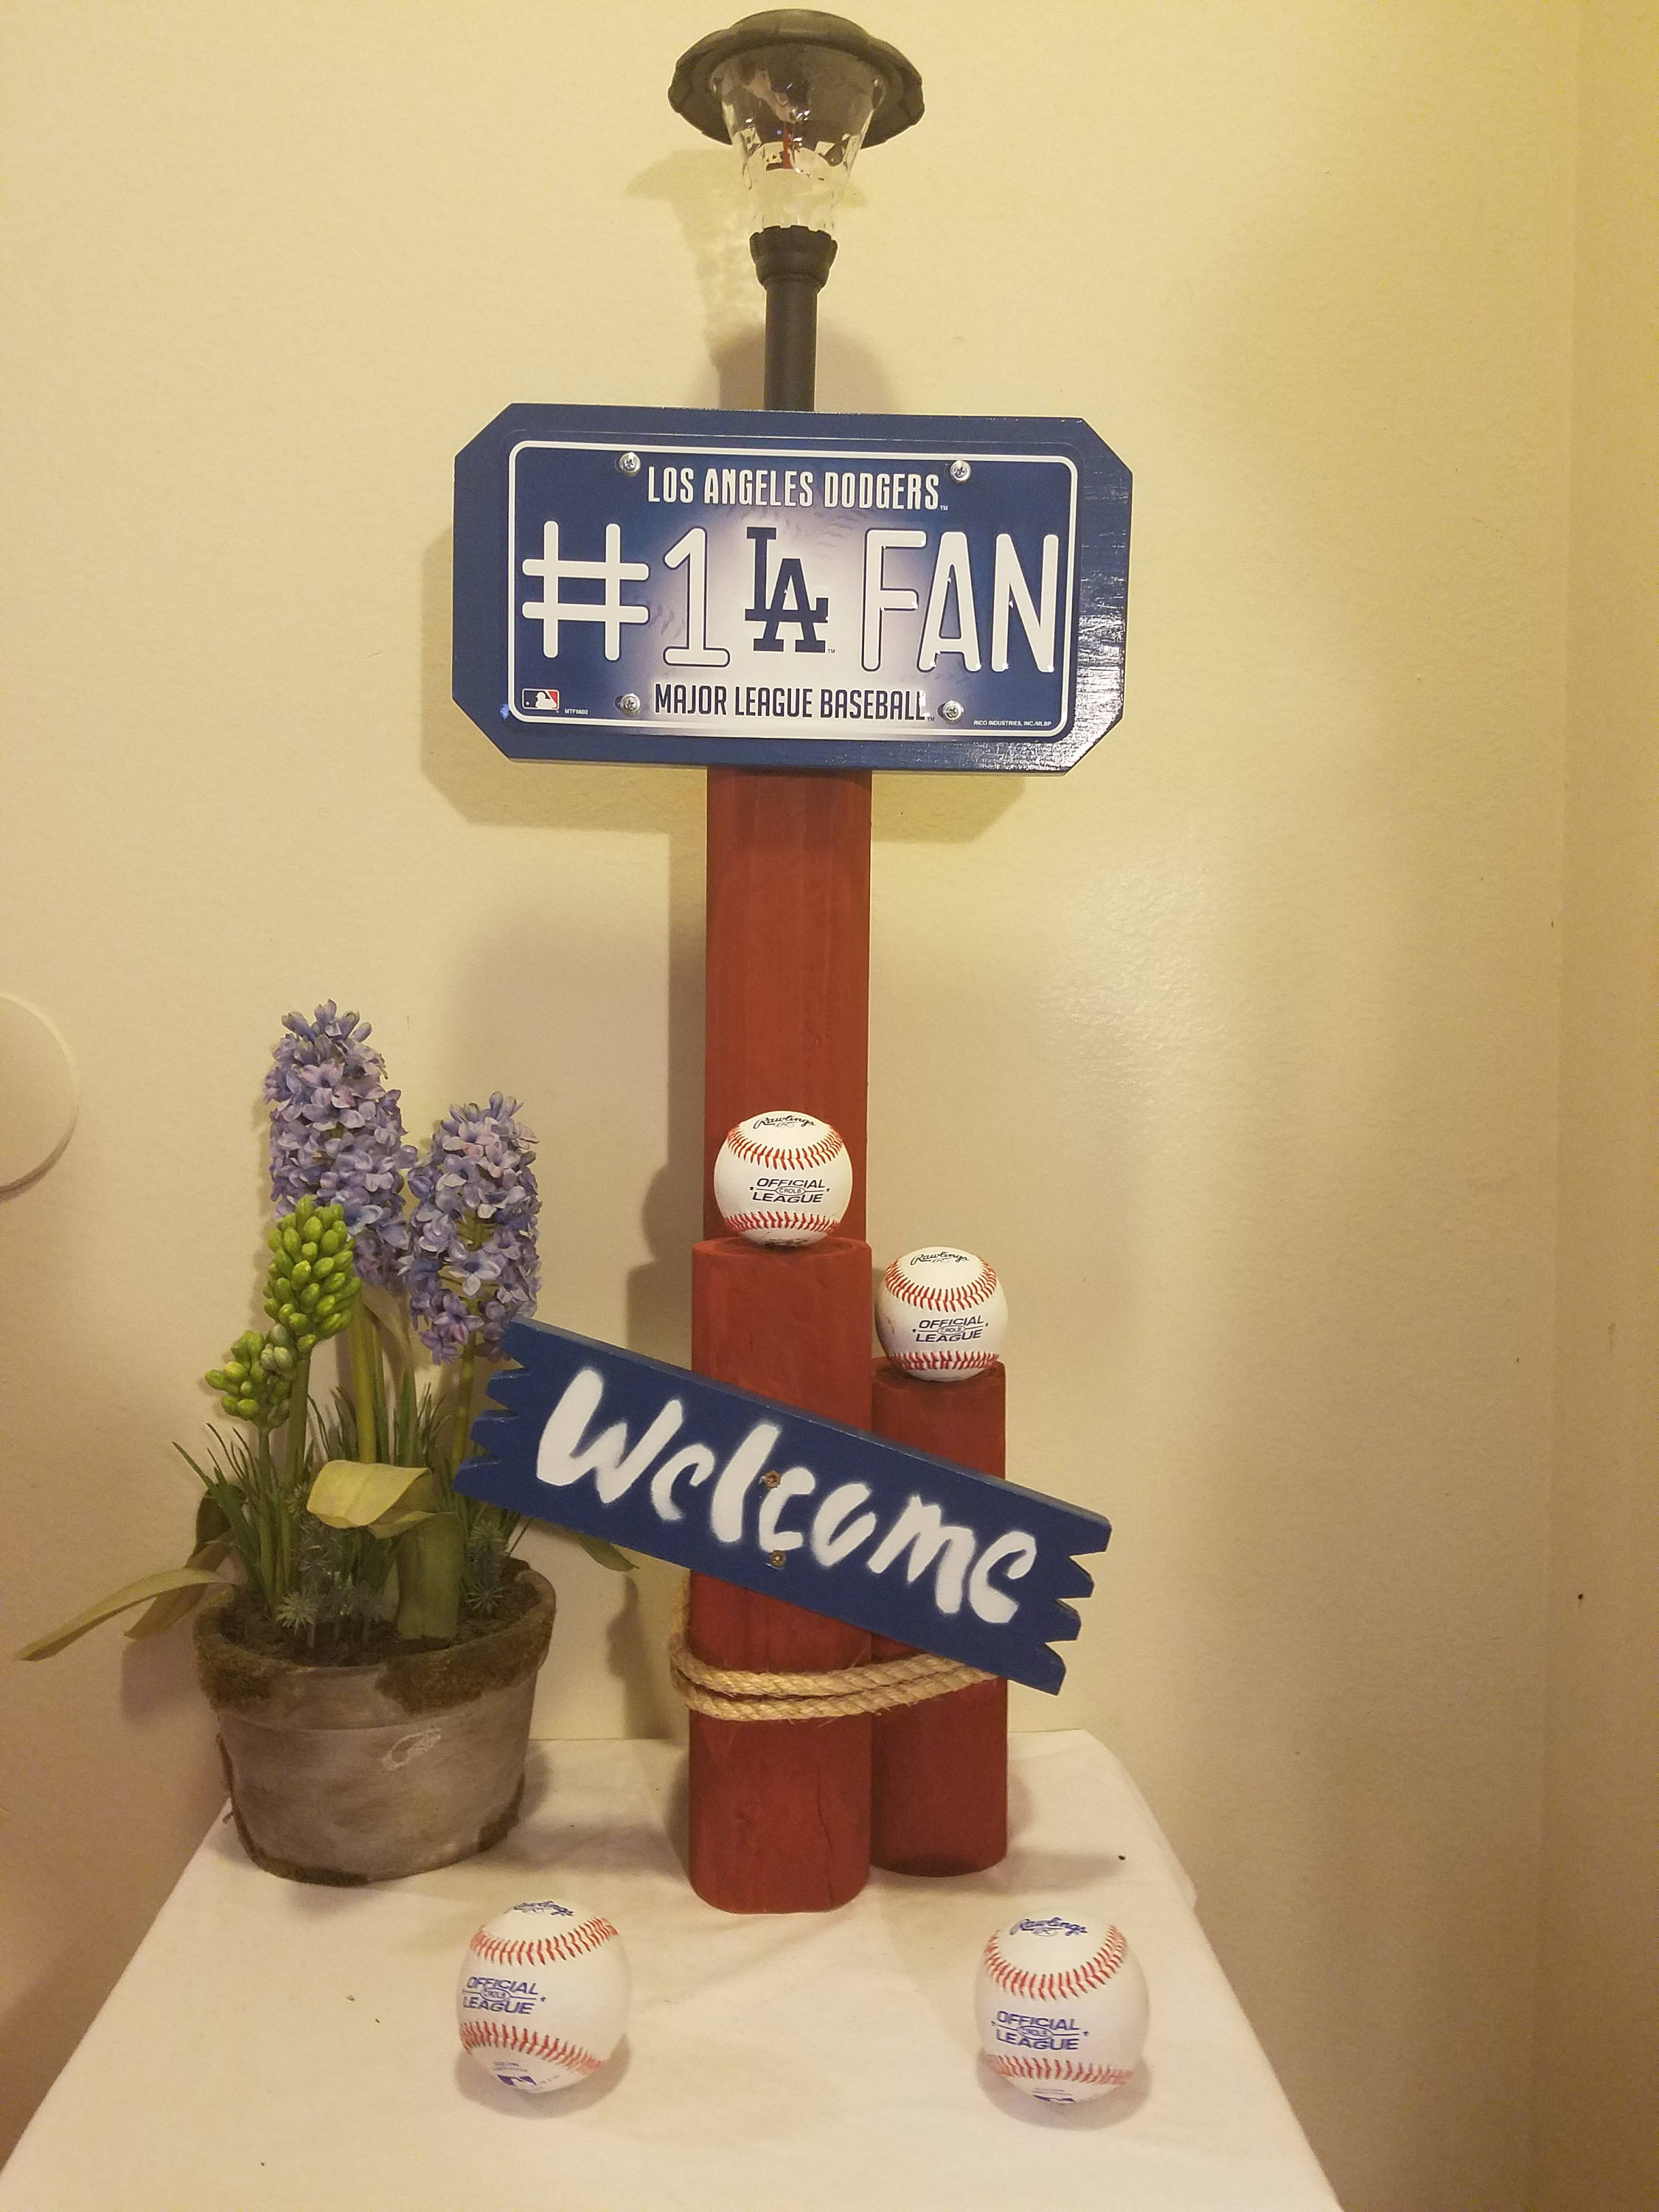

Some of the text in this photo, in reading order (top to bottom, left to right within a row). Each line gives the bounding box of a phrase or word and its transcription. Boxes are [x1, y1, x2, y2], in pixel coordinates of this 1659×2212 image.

[647, 466, 695, 504] LOS
[703, 468, 813, 507] ANGELES
[823, 472, 939, 511] DODGERS
[744, 526, 830, 654] LA
[861, 529, 1060, 672] FAN
[654, 684, 727, 717] MAJOR
[734, 686, 813, 719] LEAGUE
[820, 689, 925, 722] BASEBALL
[753, 1115, 816, 1130] Rawlings
[757, 1178, 826, 1189] OFFICIAL
[752, 1192, 824, 1203] LEAGUE
[910, 1251, 970, 1266] Rawlings
[919, 1315, 984, 1329] OFFICIAL
[915, 1329, 983, 1342] LEAGUE
[466, 1976, 538, 1995] OFFICIAL
[463, 1996, 535, 2014] LEAGUE
[996, 2010, 1080, 2030] OFFICIAL
[995, 2028, 1079, 2051] LEAGUE
